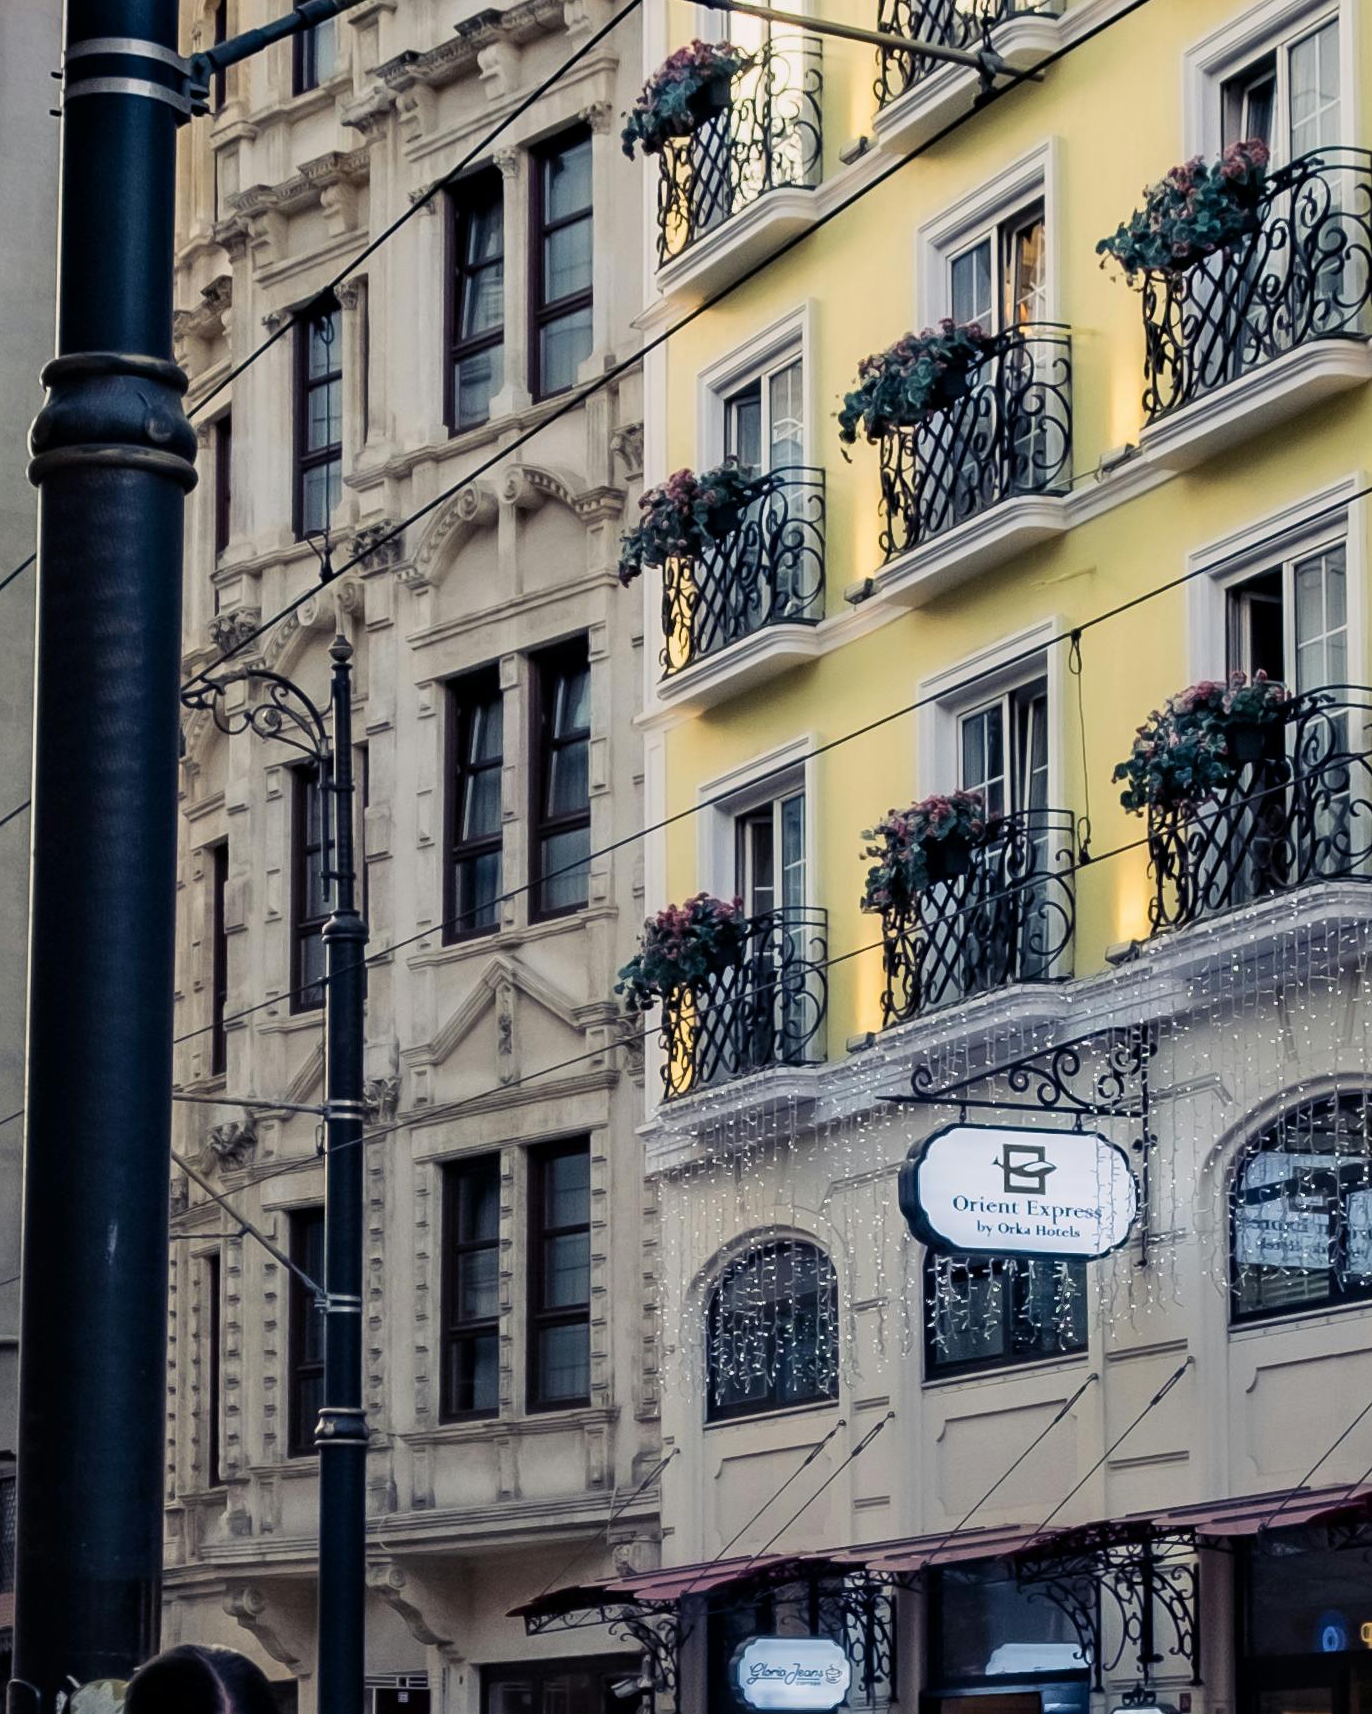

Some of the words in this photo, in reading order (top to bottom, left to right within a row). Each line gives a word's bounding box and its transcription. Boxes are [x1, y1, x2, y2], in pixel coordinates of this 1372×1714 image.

[952, 1195, 1020, 1215] Orient
[1027, 1200, 1104, 1228] Express
[977, 1220, 993, 1236] by
[998, 1221, 1031, 1236] Orka
[1036, 1224, 1081, 1238] Hotels
[746, 1662, 786, 1685] Gloria
